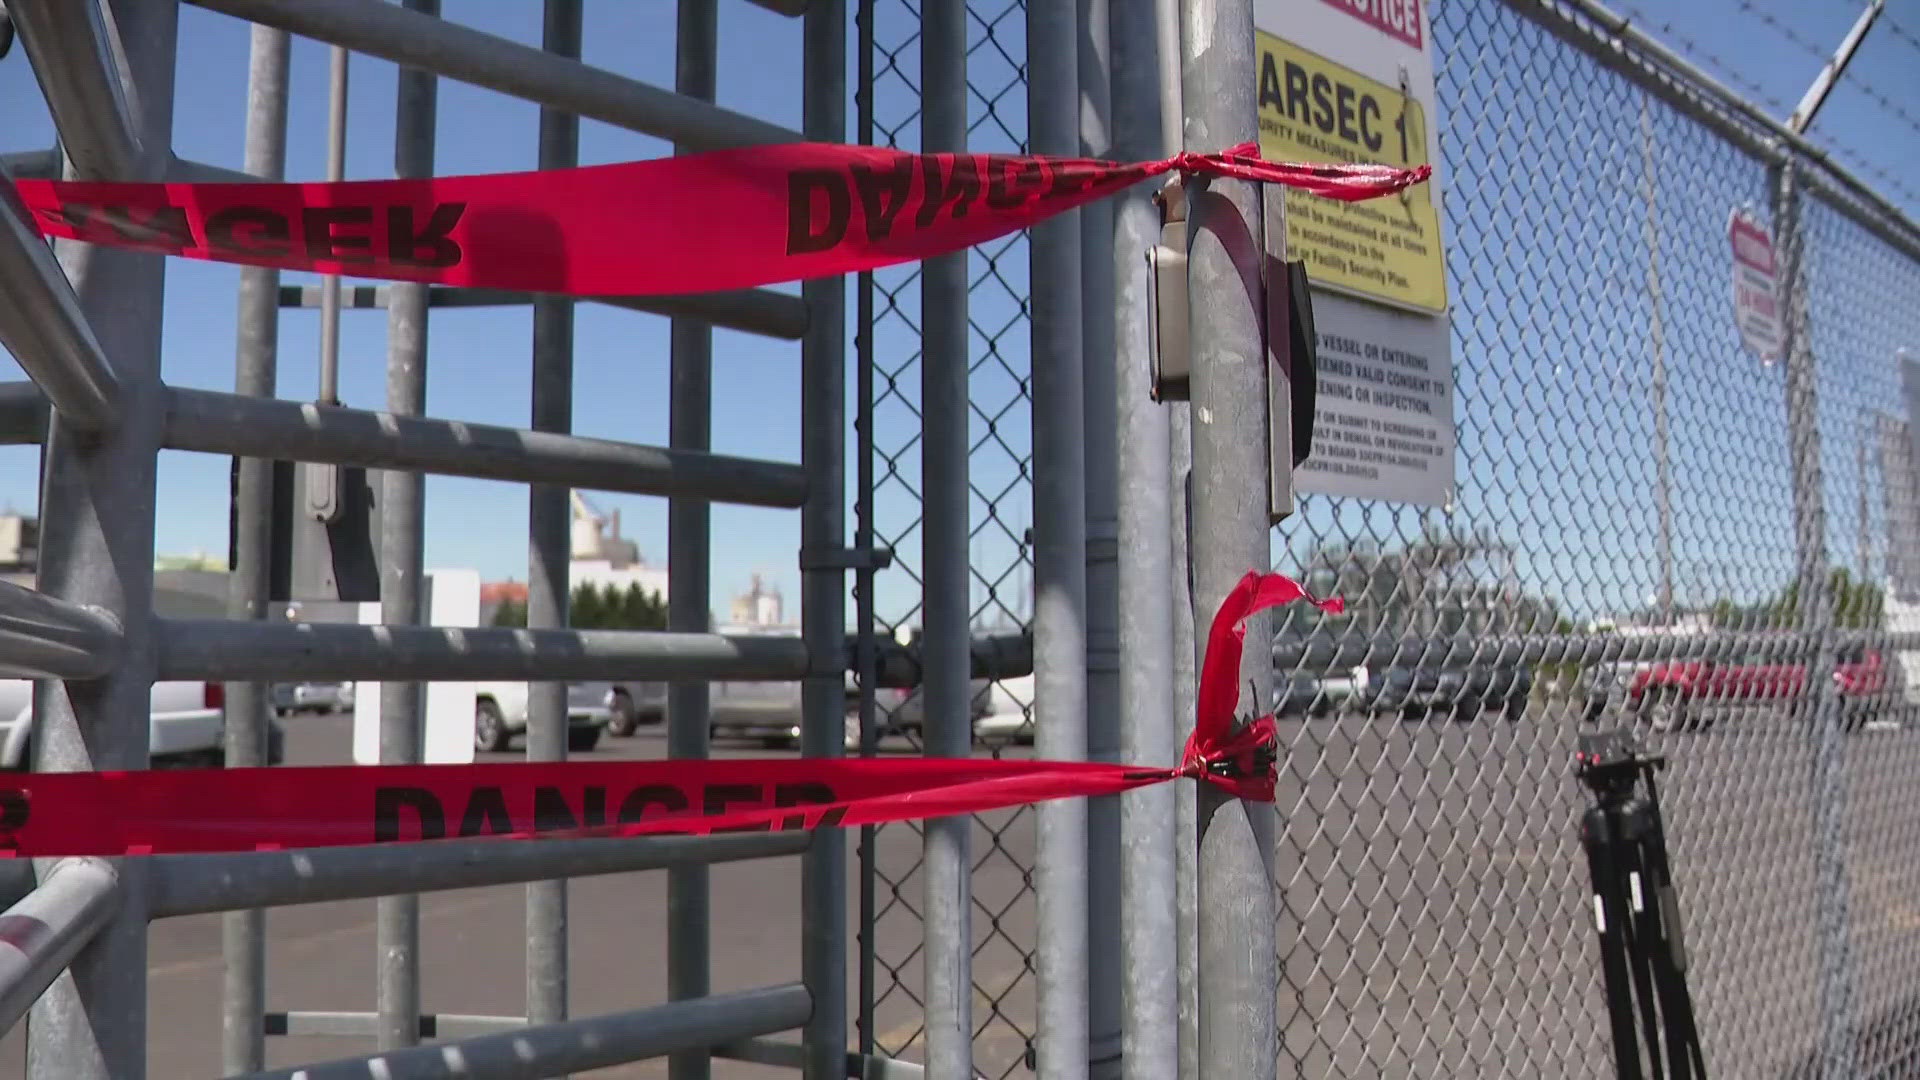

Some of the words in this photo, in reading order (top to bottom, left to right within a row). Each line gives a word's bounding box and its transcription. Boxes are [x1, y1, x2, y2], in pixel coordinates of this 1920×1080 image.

[1259, 51, 1382, 151] ARSEC
[1259, 118, 1292, 140] URITY
[1297, 130, 1355, 163] MEASURES
[1321, 333, 1361, 356] VESSEL
[1364, 343, 1379, 360] OR
[1382, 346, 1429, 372] ENTERING
[1316, 355, 1352, 377] EEMED
[1355, 364, 1384, 384] VALID
[1386, 369, 1430, 393] CONSENT
[1432, 380, 1445, 398] TO
[1317, 379, 1353, 401] ENING
[1355, 385, 1370, 404] OR
